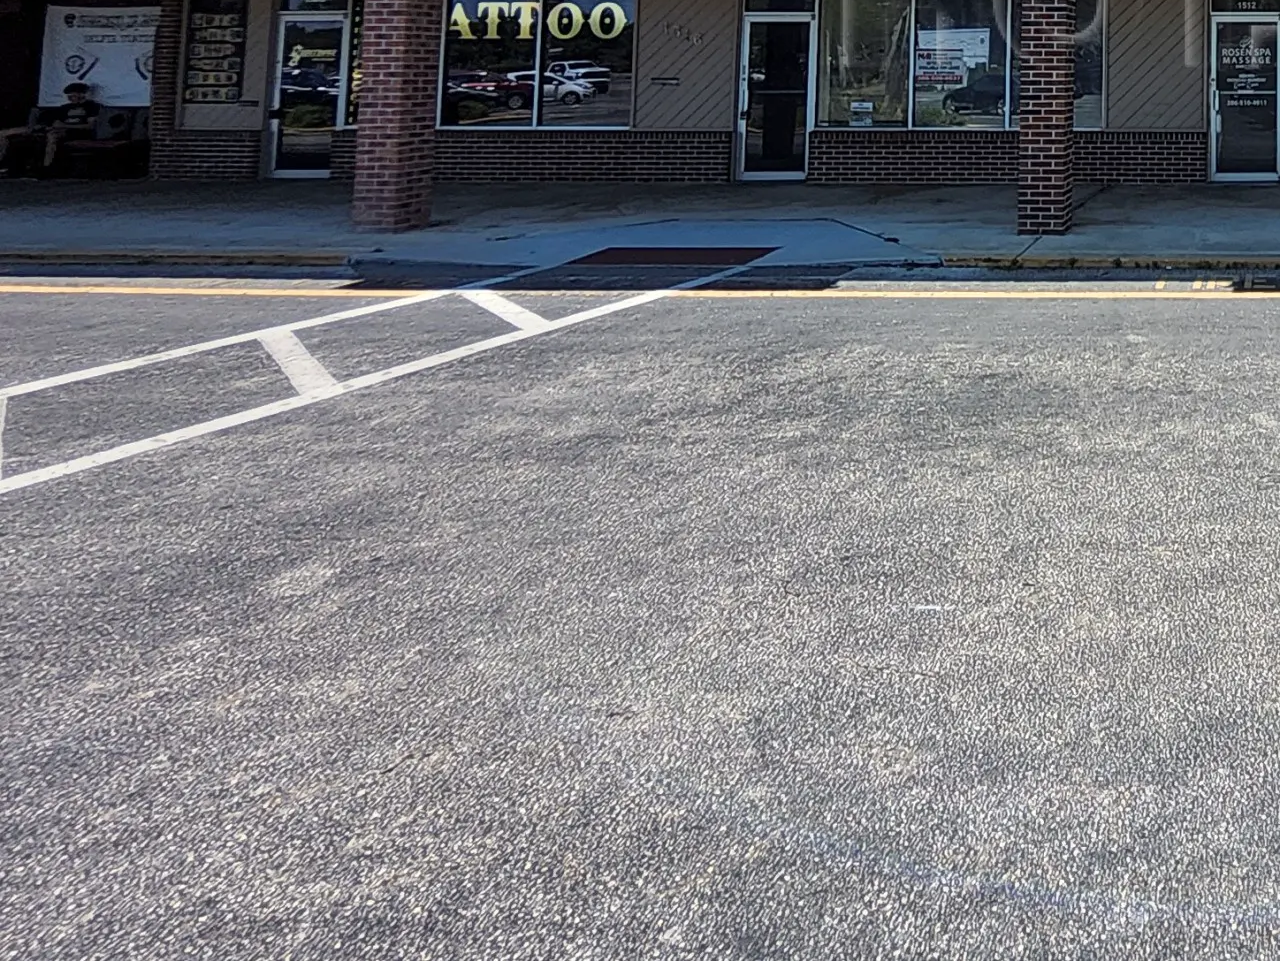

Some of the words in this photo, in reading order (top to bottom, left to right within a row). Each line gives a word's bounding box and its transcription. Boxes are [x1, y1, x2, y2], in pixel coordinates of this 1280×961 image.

[1236, 1, 1257, 10] 1512
[1221, 47, 1252, 56] ROSEN
[1253, 47, 1272, 56] SPA
[1221, 56, 1271, 64] MASSAGE
